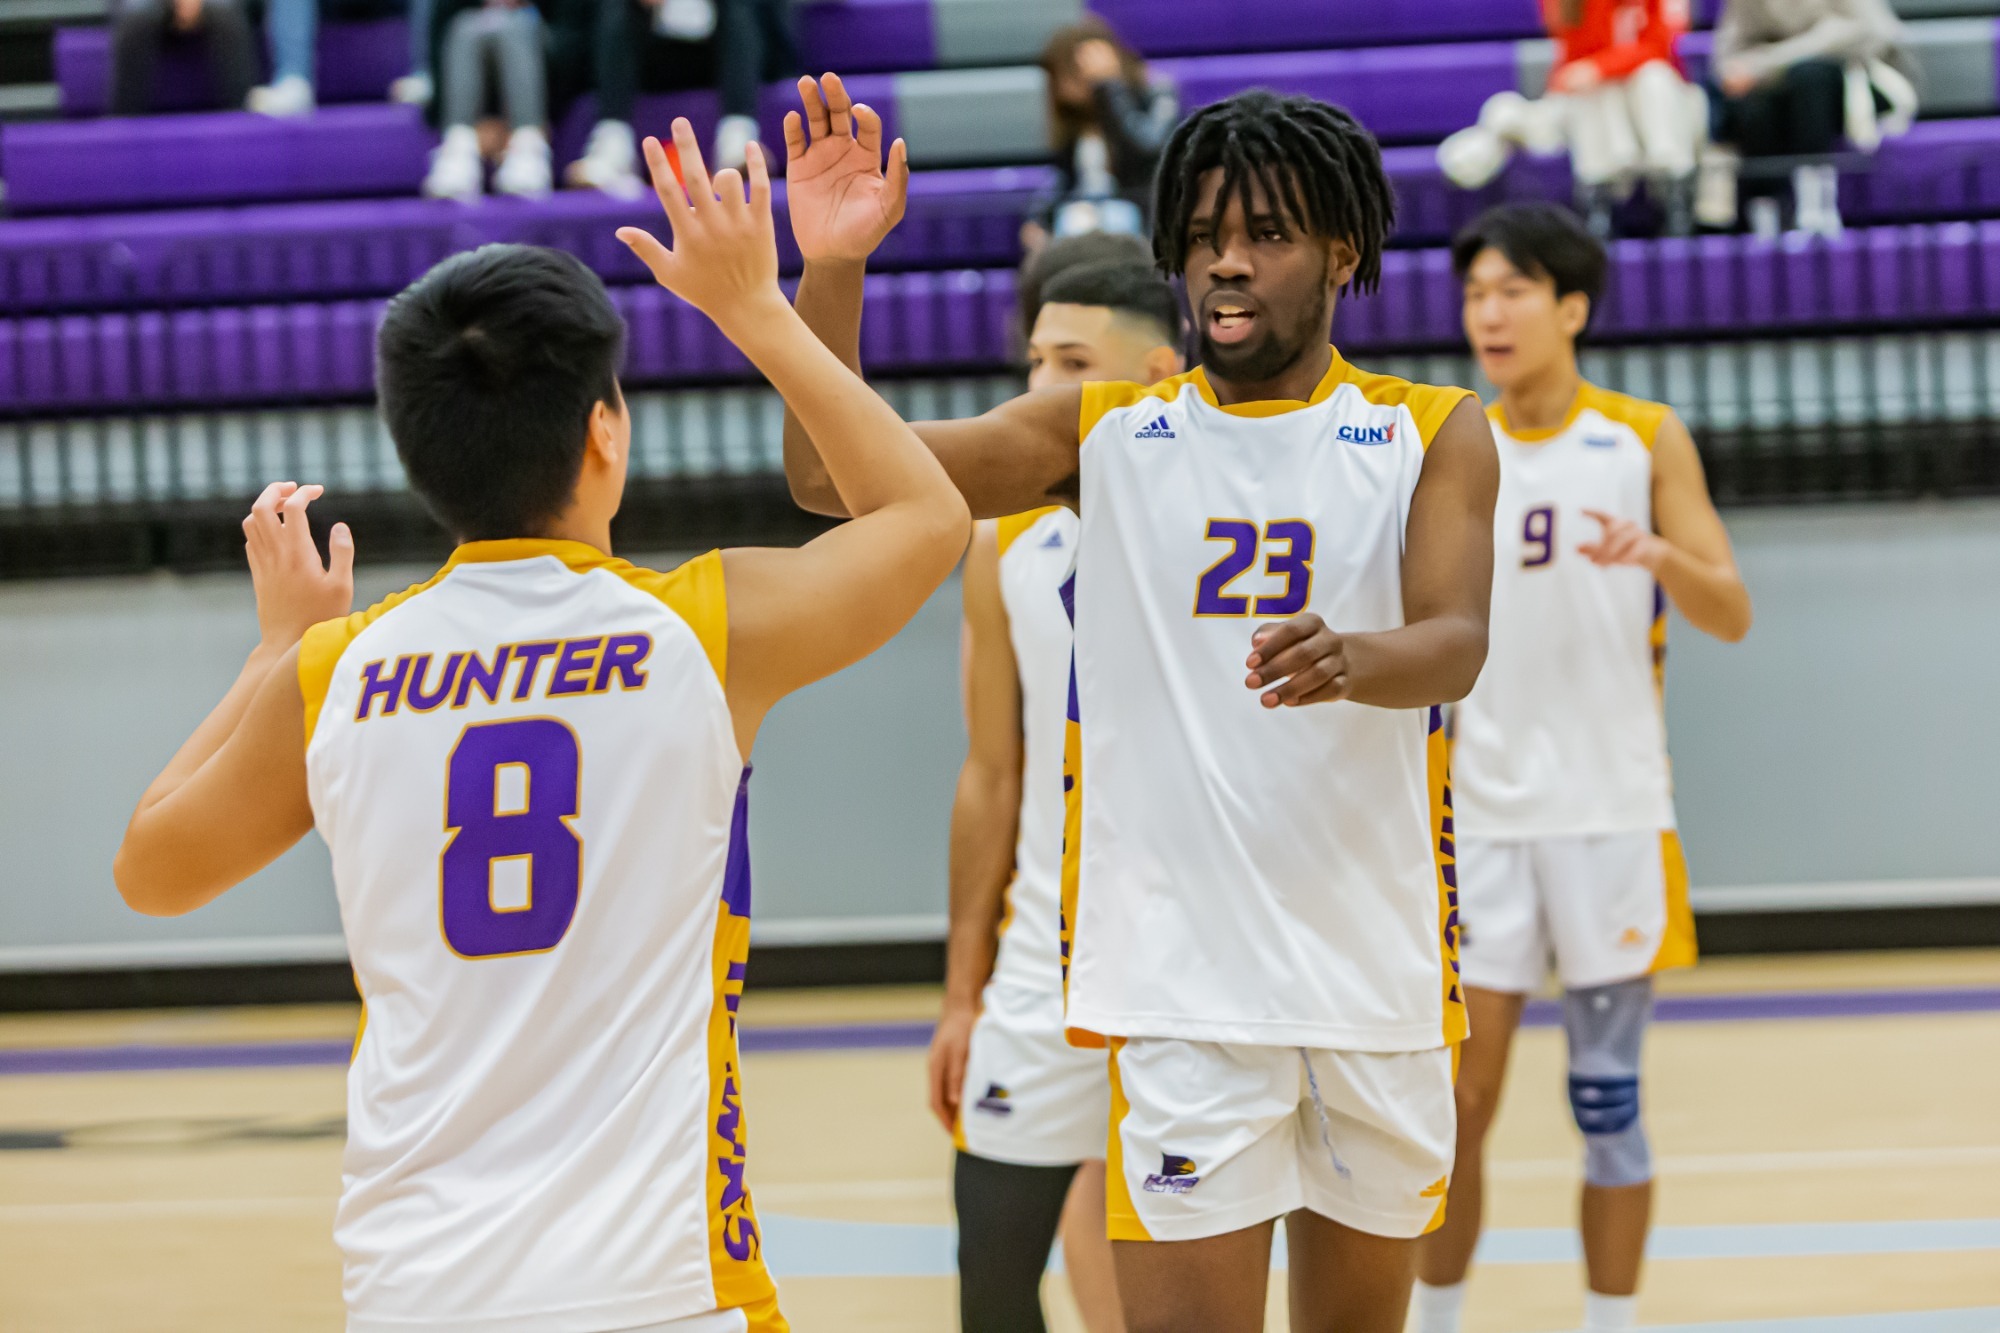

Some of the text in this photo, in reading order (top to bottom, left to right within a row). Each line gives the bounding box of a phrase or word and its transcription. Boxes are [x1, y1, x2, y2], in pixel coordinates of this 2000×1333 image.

[1134, 429, 1176, 439] adidas
[1337, 423, 1396, 444] CUNY
[1192, 517, 1316, 618] 23
[1518, 503, 1558, 570] 9
[354, 630, 654, 723] HUNTER
[438, 714, 585, 961] 8
